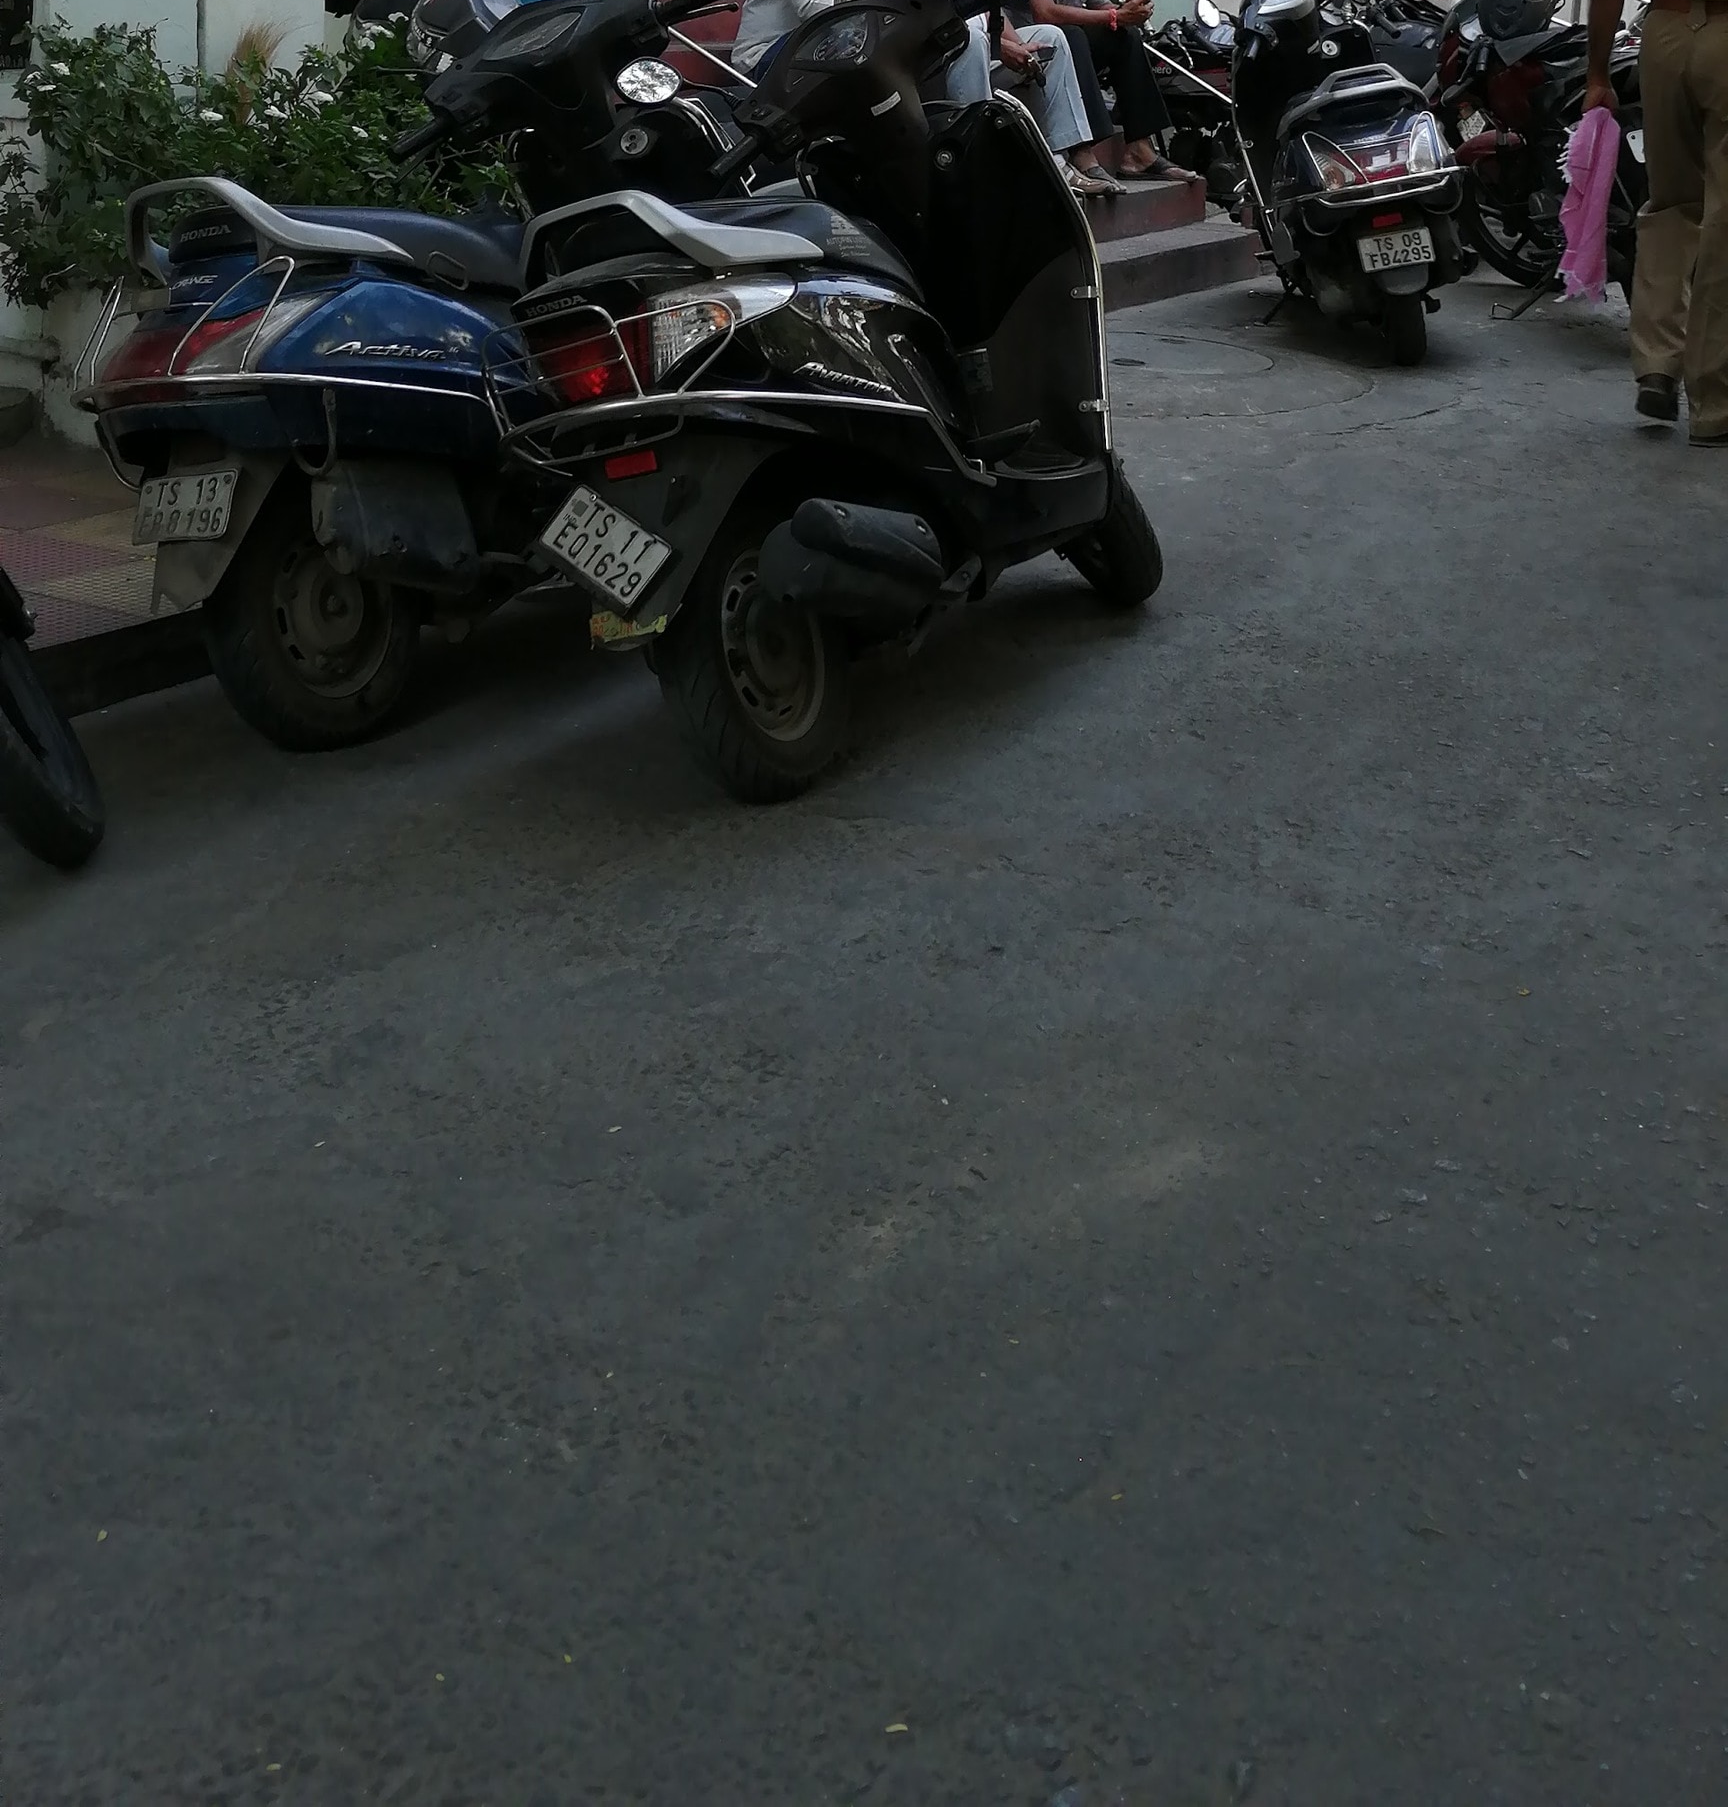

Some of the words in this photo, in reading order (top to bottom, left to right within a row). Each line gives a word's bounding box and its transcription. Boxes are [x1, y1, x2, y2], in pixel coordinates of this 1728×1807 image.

[179, 224, 232, 243] HONDA
[1374, 237, 1394, 253] TS
[1402, 232, 1422, 248] 09
[1369, 245, 1432, 269] FB4295
[525, 295, 587, 317] HONDA
[324, 341, 446, 360] Activa
[157, 480, 181, 508] TS
[195, 476, 218, 505] 13
[583, 501, 616, 539] TS
[620, 530, 658, 565] 11
